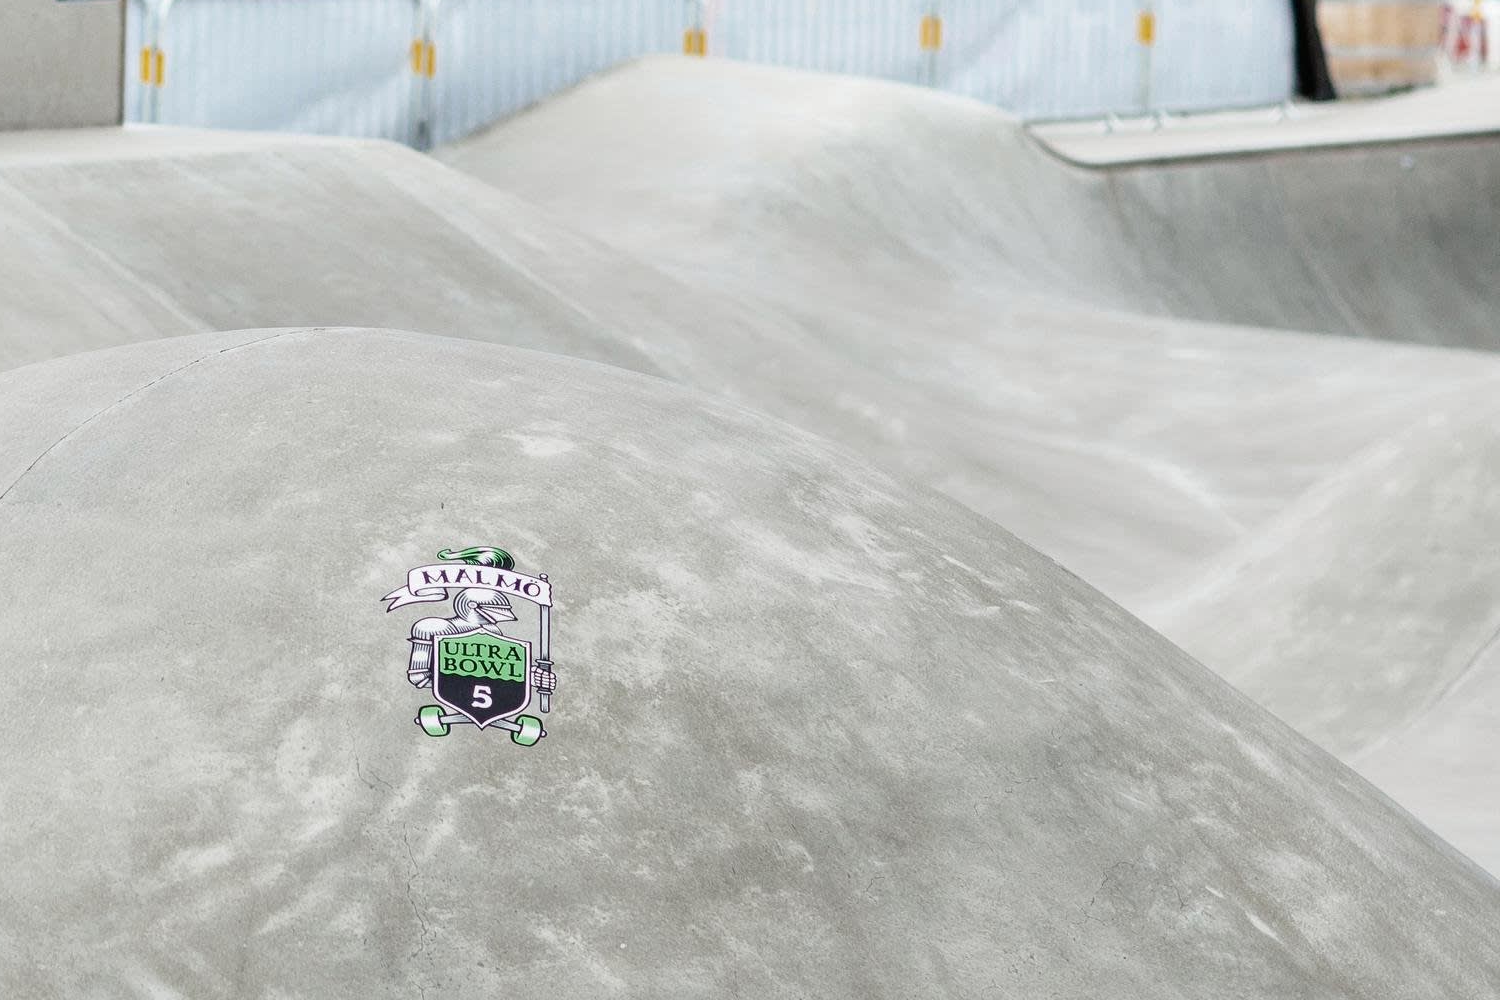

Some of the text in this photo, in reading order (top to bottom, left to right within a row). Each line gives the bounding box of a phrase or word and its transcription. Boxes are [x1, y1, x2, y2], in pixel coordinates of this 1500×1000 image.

[421, 568, 541, 597] MALMÖ
[443, 641, 522, 662] ULTRA
[443, 657, 522, 678] BOWL
[471, 685, 493, 709] 5
